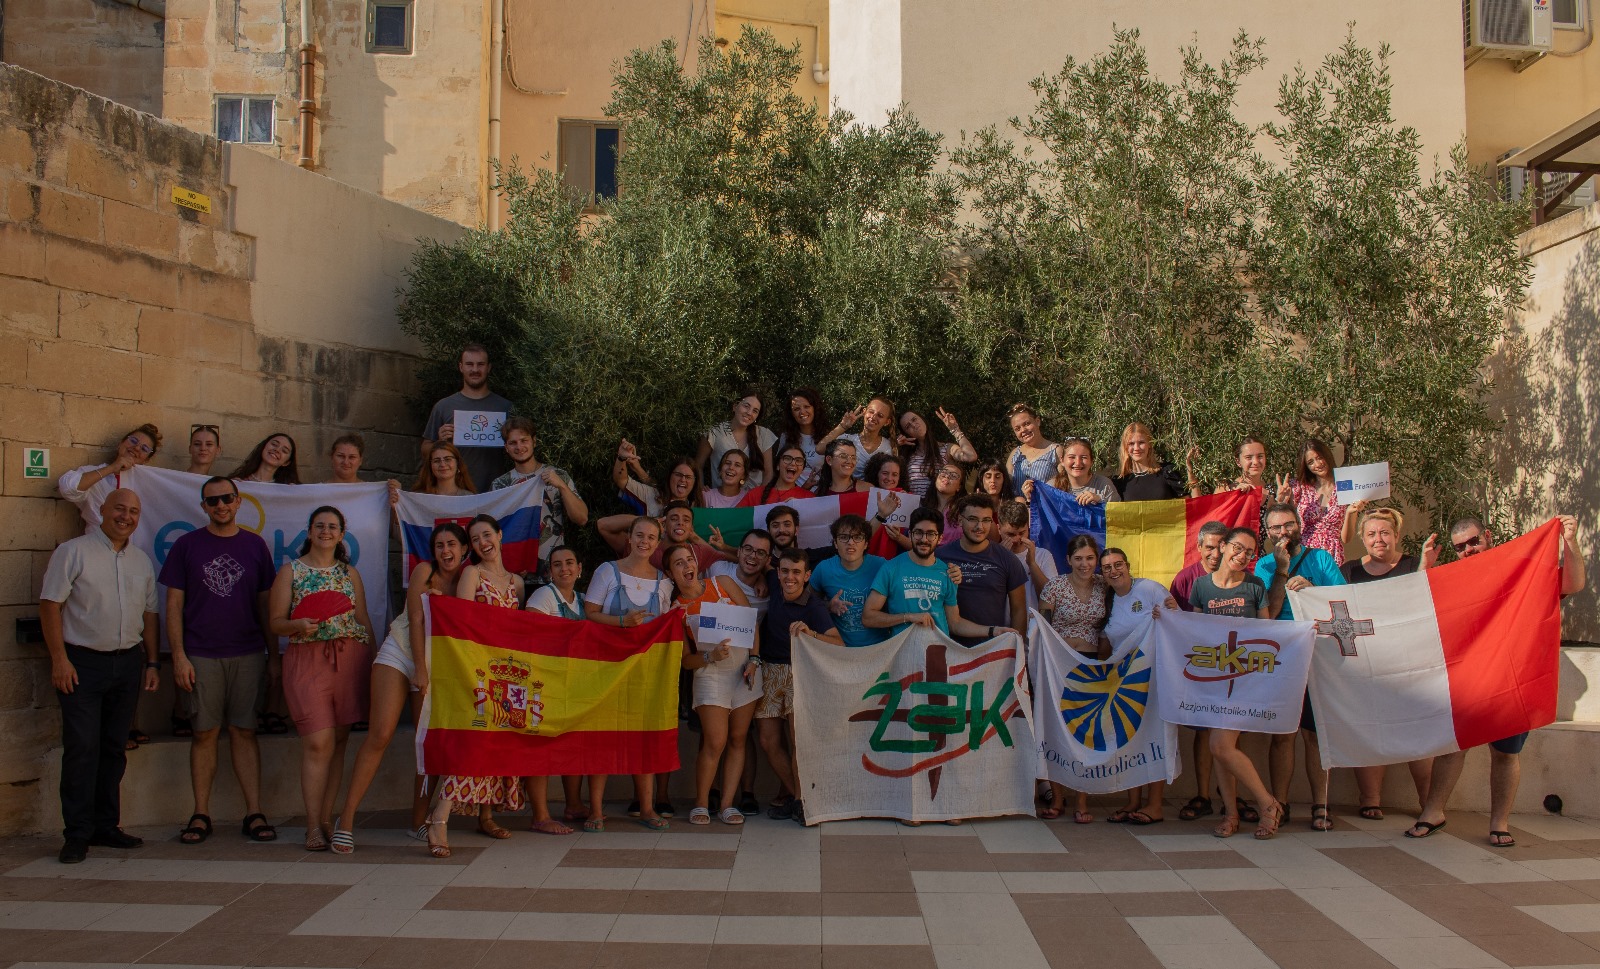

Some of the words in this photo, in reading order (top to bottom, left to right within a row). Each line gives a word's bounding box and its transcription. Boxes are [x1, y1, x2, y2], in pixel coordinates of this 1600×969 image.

[174, 196, 208, 212] TRESPASSING
[188, 192, 197, 200] NO
[463, 432, 496, 443] eupa
[1178, 700, 1210, 714] Azzjoni
[1210, 703, 1247, 717] Kattolika
[1248, 708, 1277, 721] Maltija
[1071, 751, 1148, 779] Cattolica
